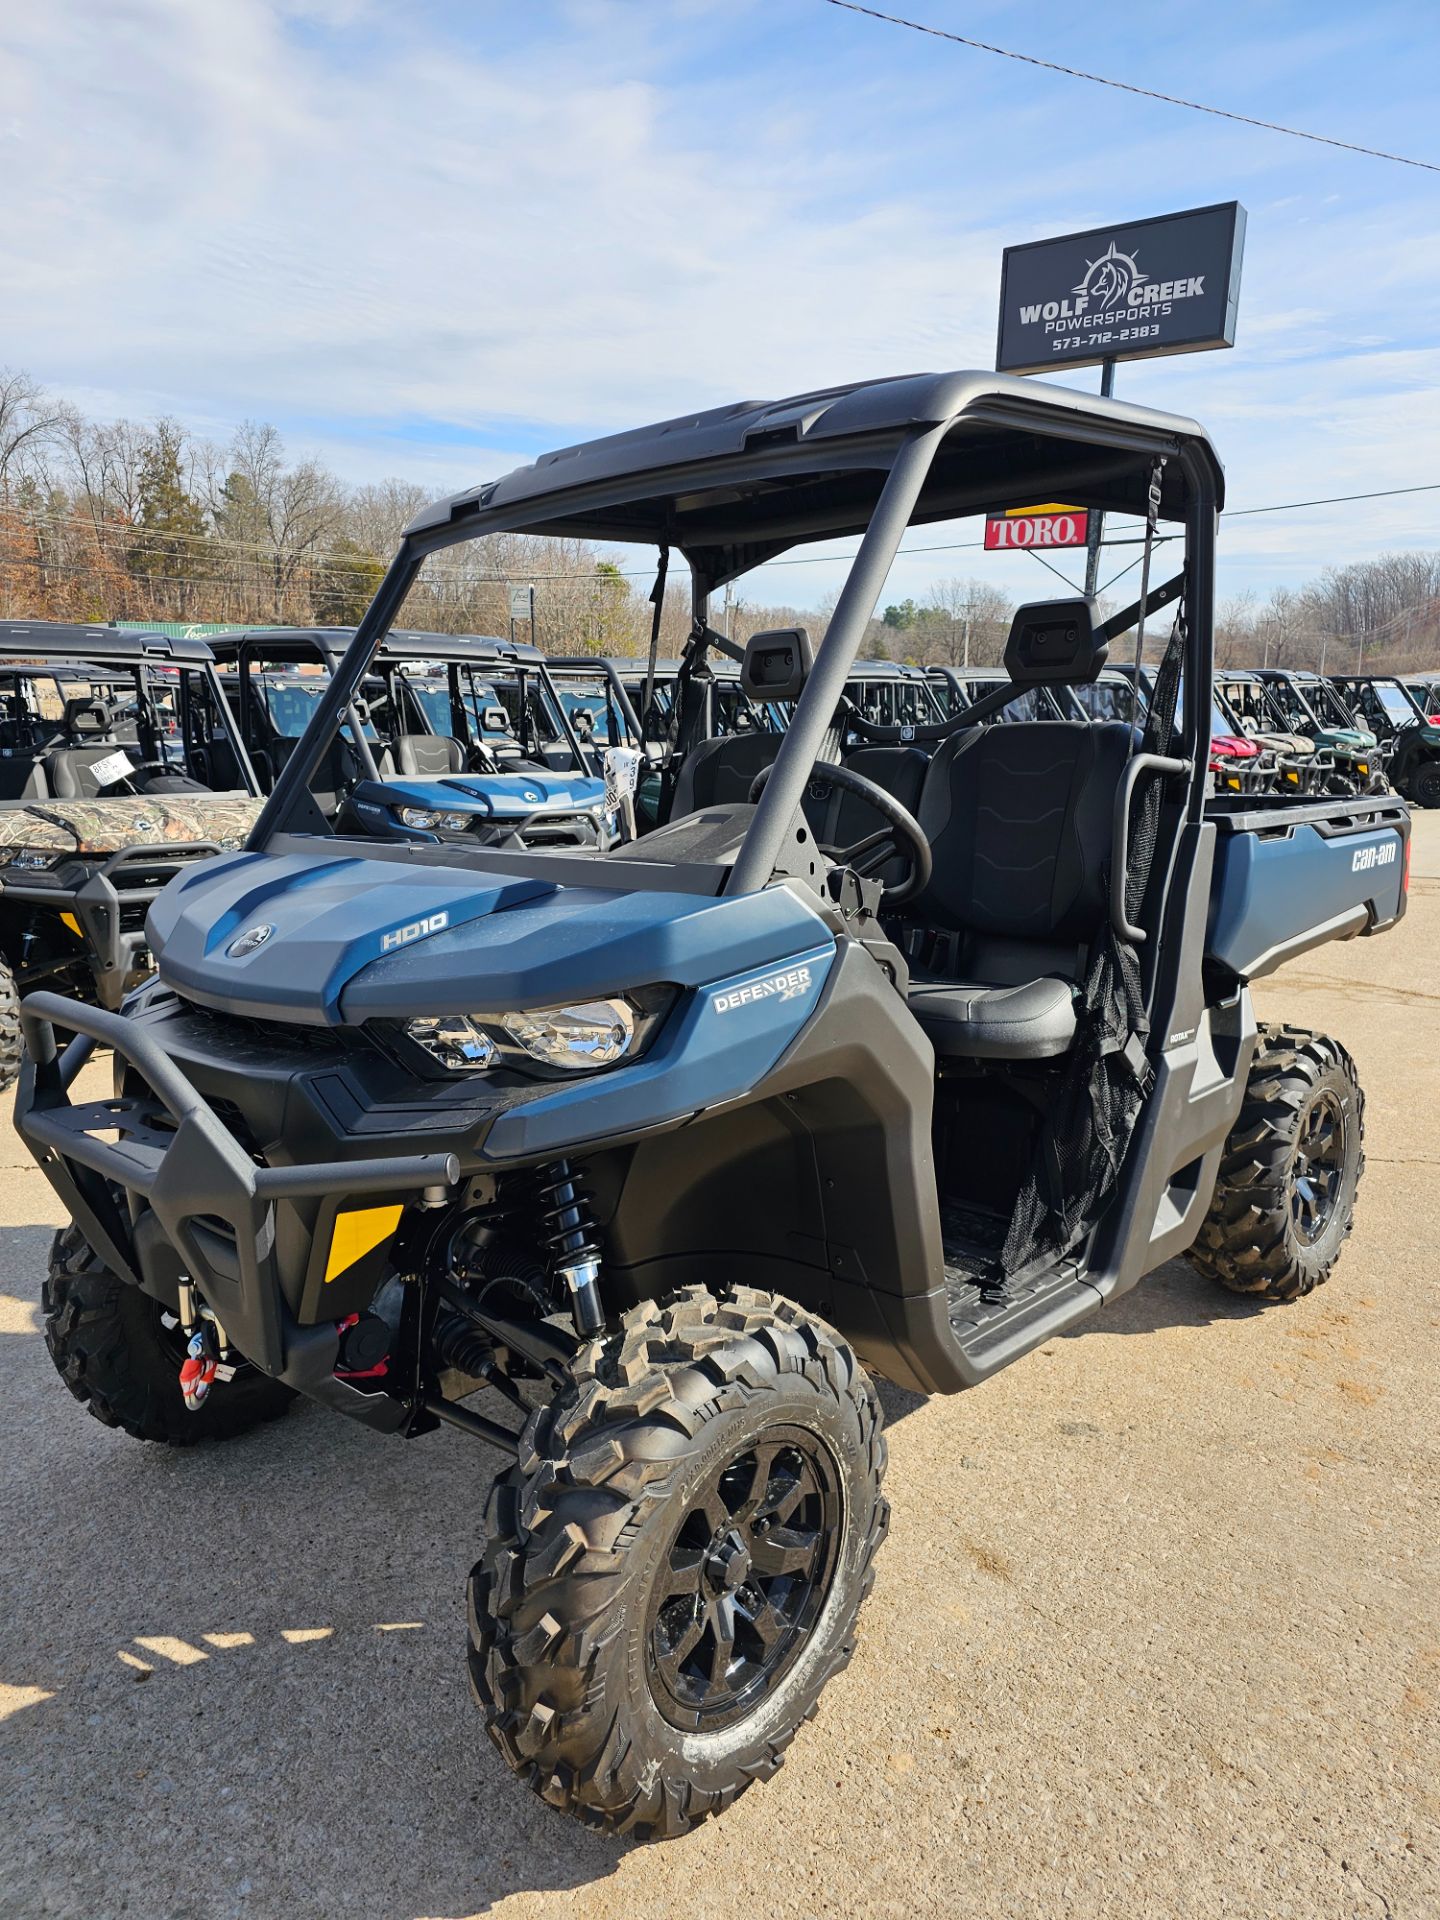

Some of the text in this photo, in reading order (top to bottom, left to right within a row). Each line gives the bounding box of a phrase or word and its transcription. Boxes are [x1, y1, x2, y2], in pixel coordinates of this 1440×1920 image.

[1019, 275, 1206, 325] WOLF CREEK
[1045, 302, 1172, 334] POWERSPORTS
[1052, 324, 1160, 352] 573-712-2383
[992, 516, 1076, 547] TORO
[1352, 842, 1396, 873] can-am
[383, 911, 448, 951] HD10
[713, 967, 811, 1015] DEFENDER
